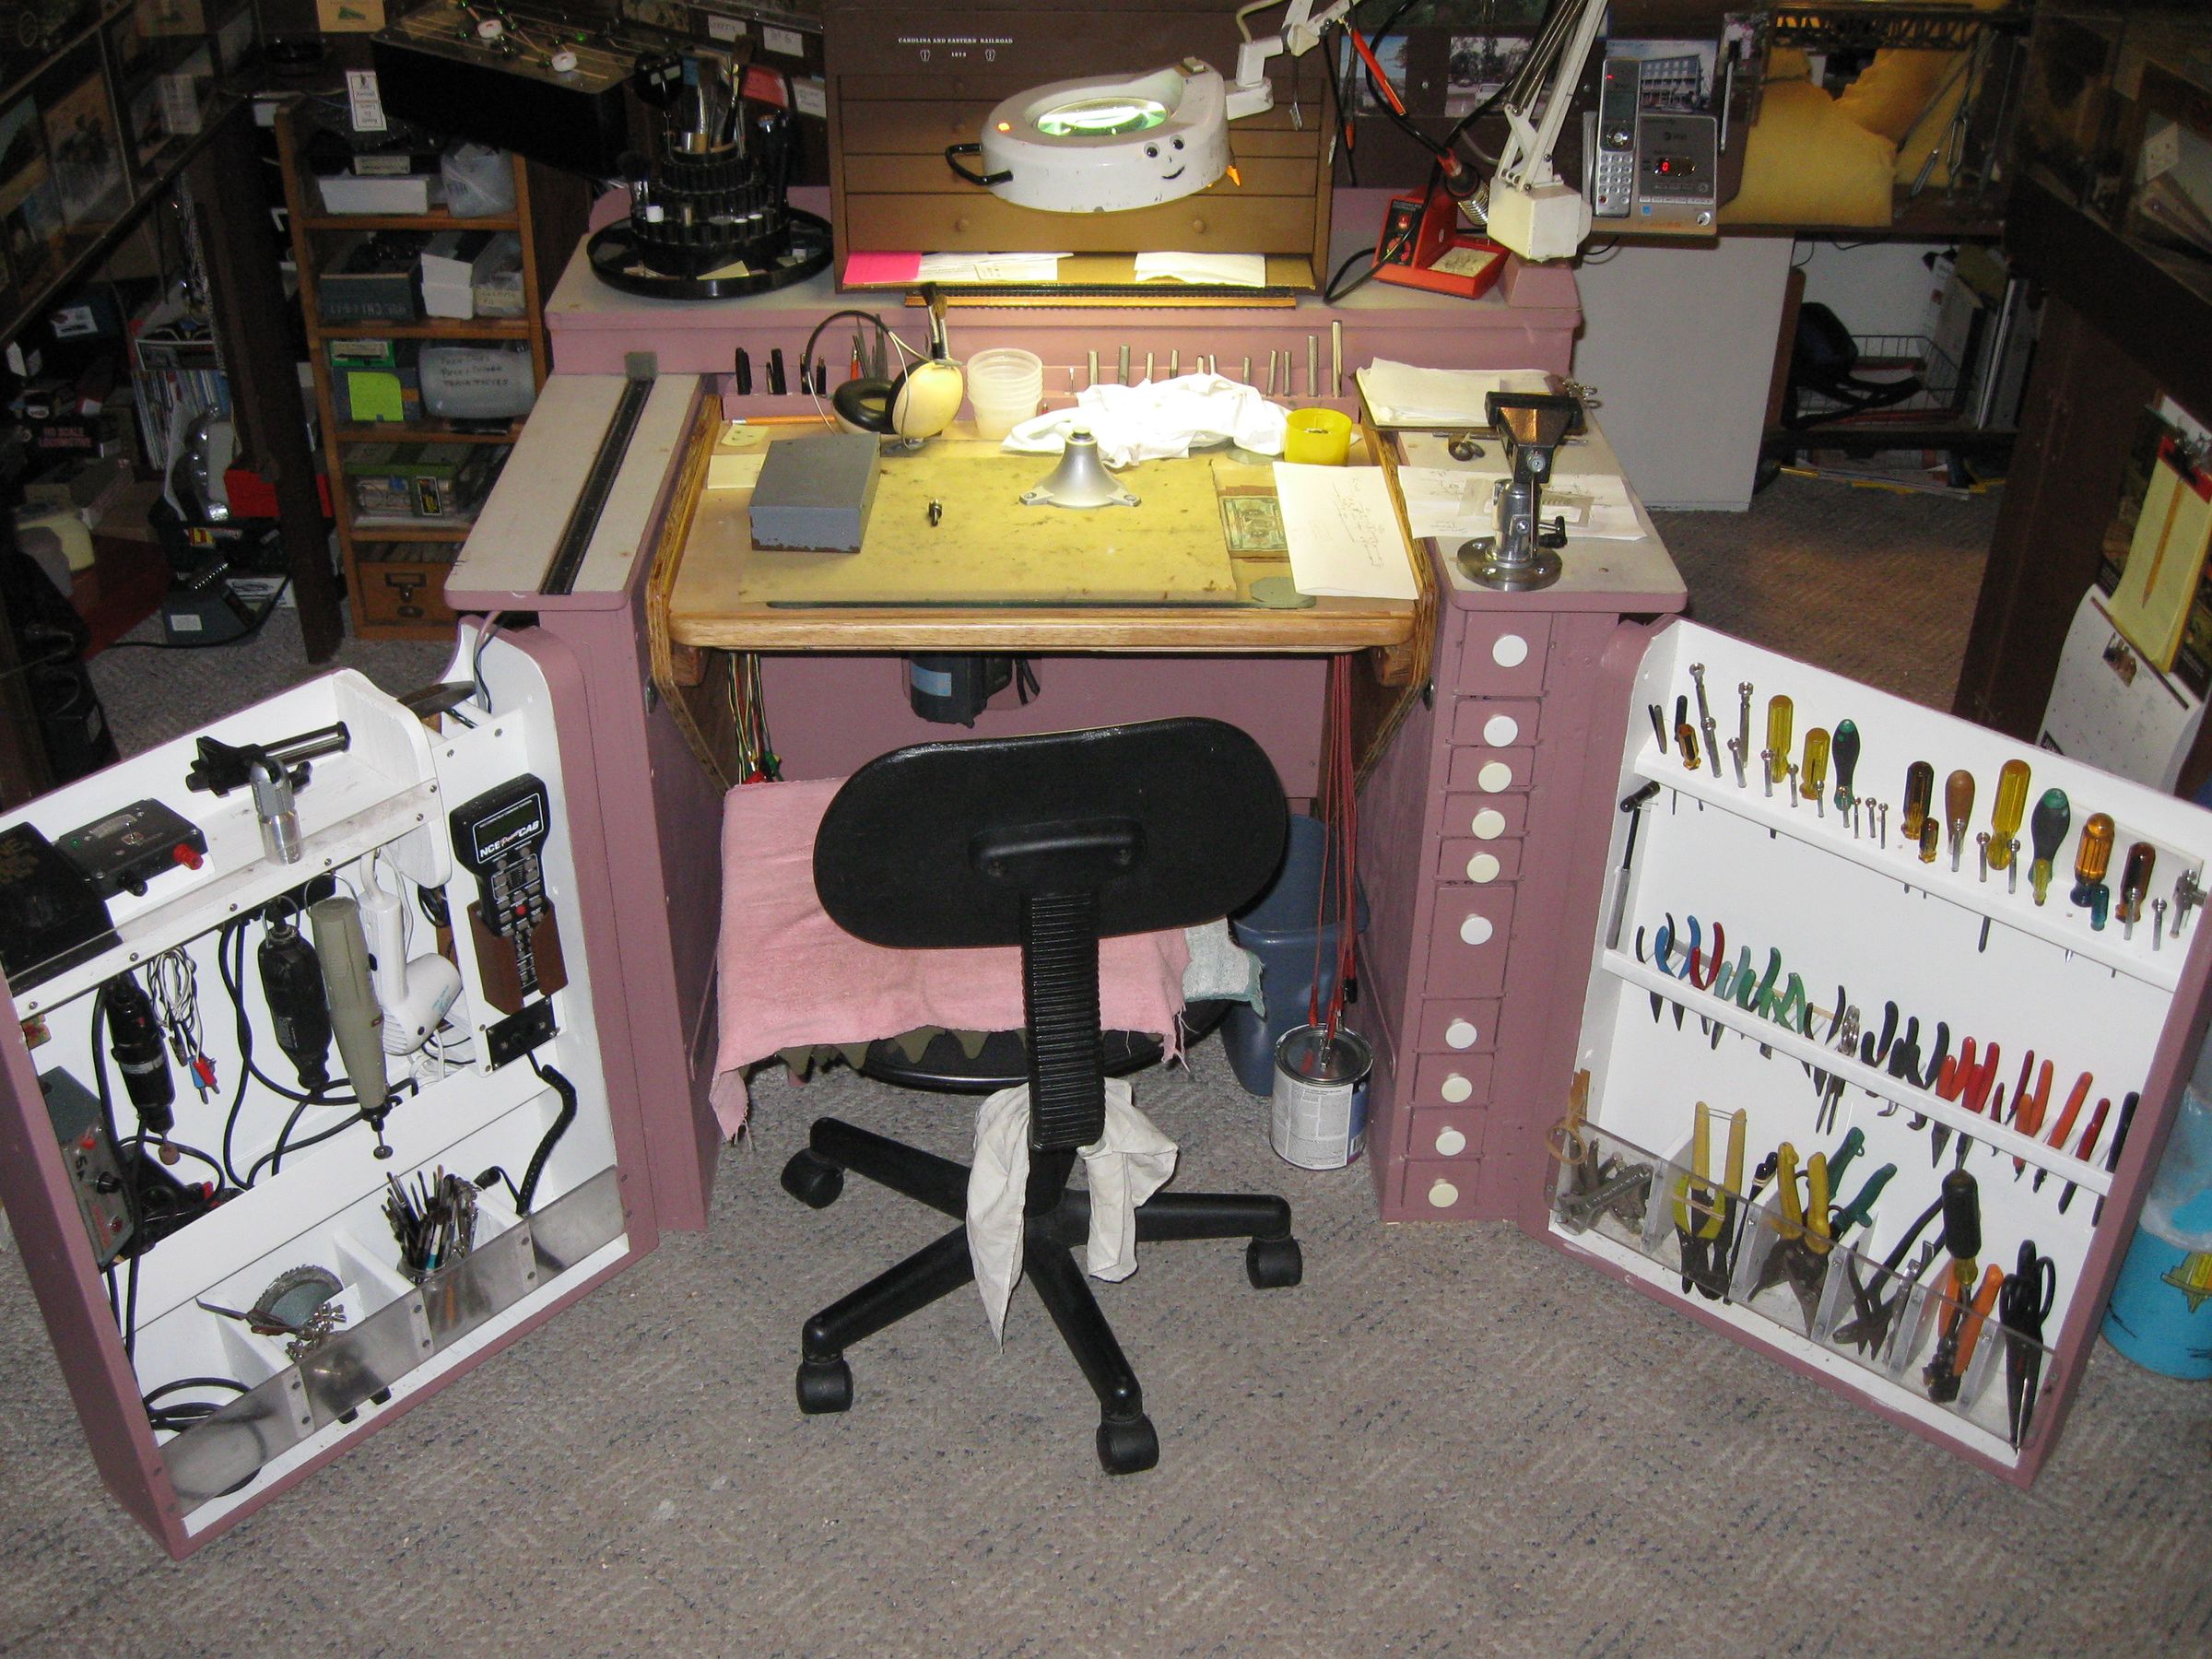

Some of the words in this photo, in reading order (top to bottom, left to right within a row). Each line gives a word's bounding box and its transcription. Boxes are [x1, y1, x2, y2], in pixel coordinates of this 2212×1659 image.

[1662, 161, 1668, 171] 0
[480, 840, 501, 858] NCE
[518, 820, 540, 838] CAB
